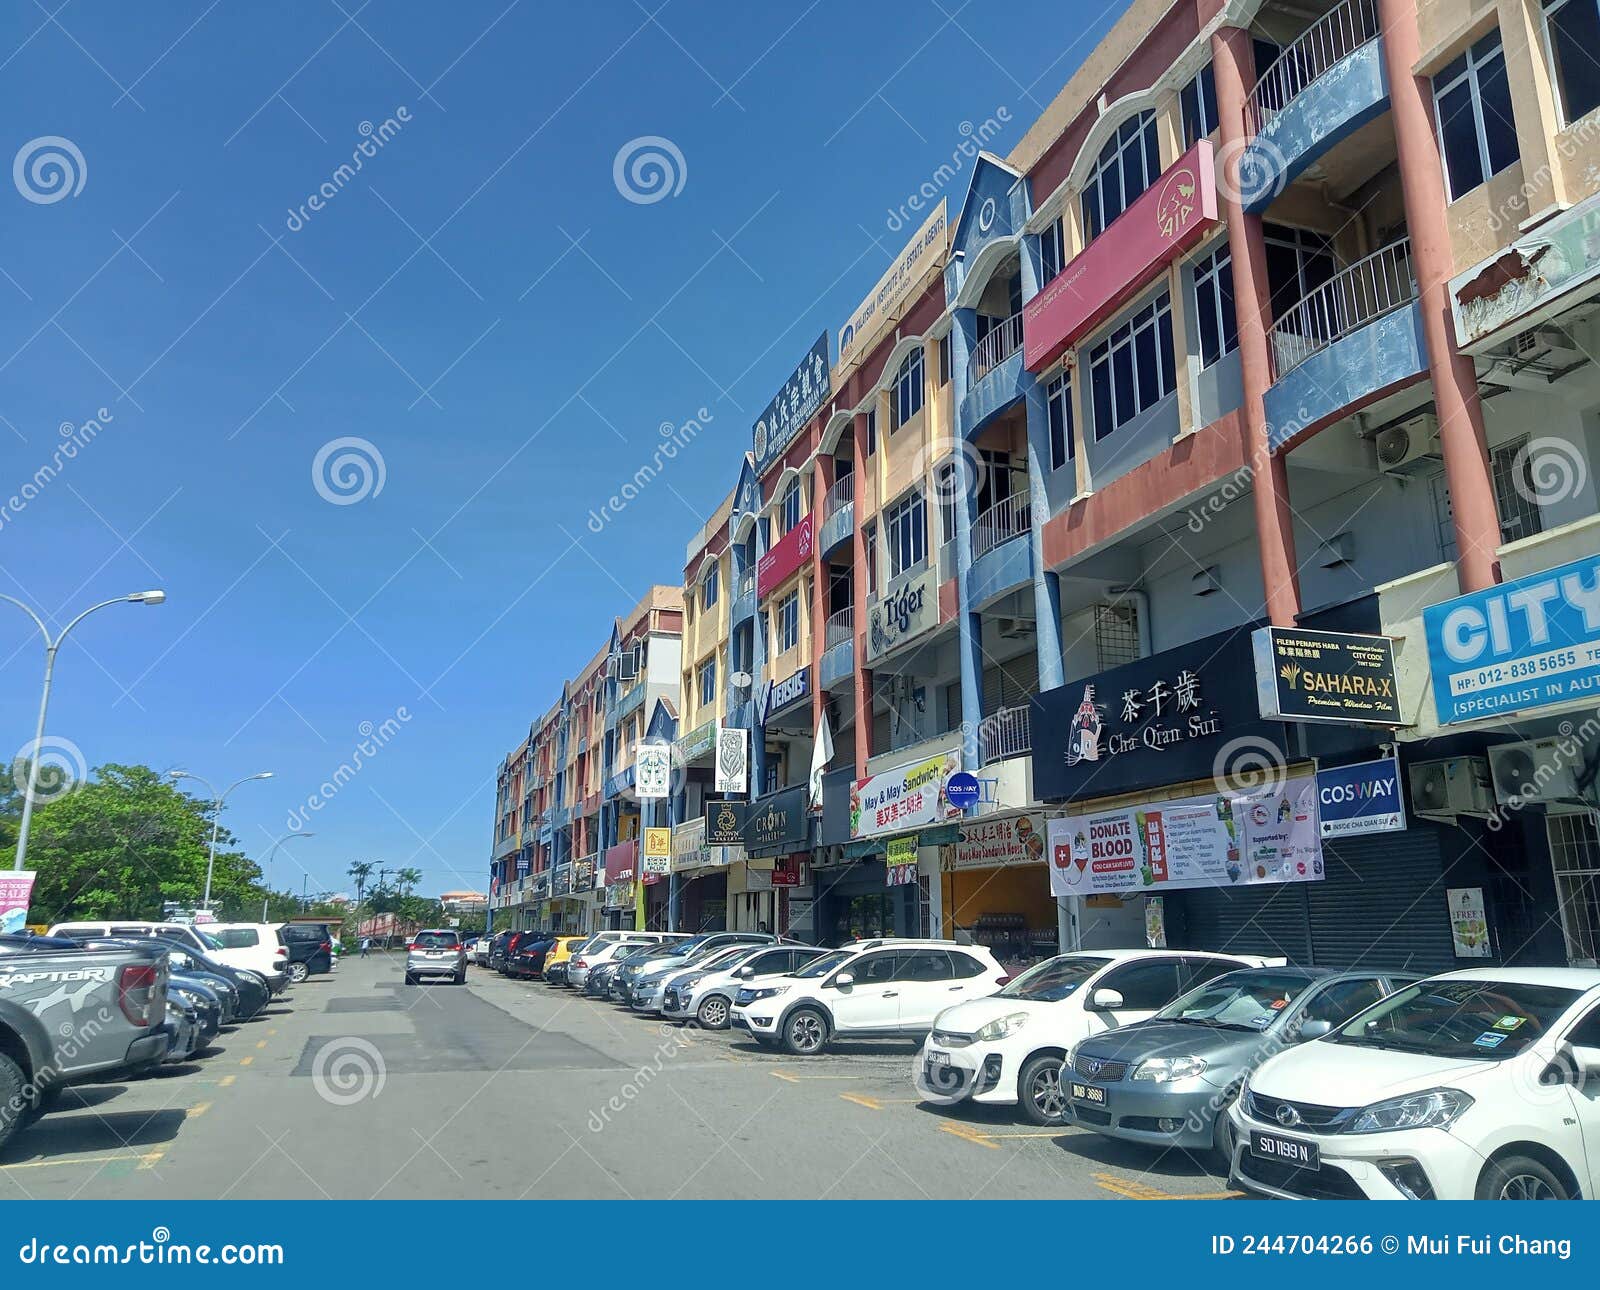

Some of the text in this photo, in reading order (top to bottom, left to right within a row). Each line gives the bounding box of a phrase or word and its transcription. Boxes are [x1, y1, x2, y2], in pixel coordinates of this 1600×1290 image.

[1160, 205, 1194, 238] AIA
[877, 272, 898, 306] INSTITUTE
[900, 262, 906, 280] OF
[906, 241, 923, 271] ESTATE
[924, 216, 944, 249] AGENTS
[884, 582, 926, 633] Tiger
[1442, 566, 1600, 663] CITY
[1296, 640, 1322, 648] PENAPIS
[1322, 642, 1339, 650] HABA
[1353, 652, 1384, 661] CITY COOL
[1457, 678, 1475, 690] HP:
[1540, 651, 1576, 671] 5655
[771, 671, 806, 710] VERSUS
[1120, 670, 1202, 723] 茶千歲
[1303, 672, 1393, 697] SAHARA-X
[1308, 696, 1392, 711] Premium Window Film
[1454, 688, 1539, 716] (SPECIALIST
[1547, 684, 1562, 696] IN
[1109, 710, 1221, 755] Cha Qian Sui
[865, 764, 939, 811] May & May Sandwich
[1320, 778, 1395, 805] COSWAY
[756, 811, 787, 832] CROWN
[876, 791, 923, 828] 美又美三明治
[1090, 821, 1131, 840] DONATE
[1253, 834, 1278, 844] Supported
[1333, 822, 1350, 830] INSIDE
[982, 843, 1006, 858] Sandwich
[1092, 838, 1132, 858] BLOOD
[1148, 820, 1163, 875] FREE
[0, 889, 28, 899] SALE
[1456, 910, 1476, 919] FREE
[1260, 1137, 1309, 1161] SD 1199 N
